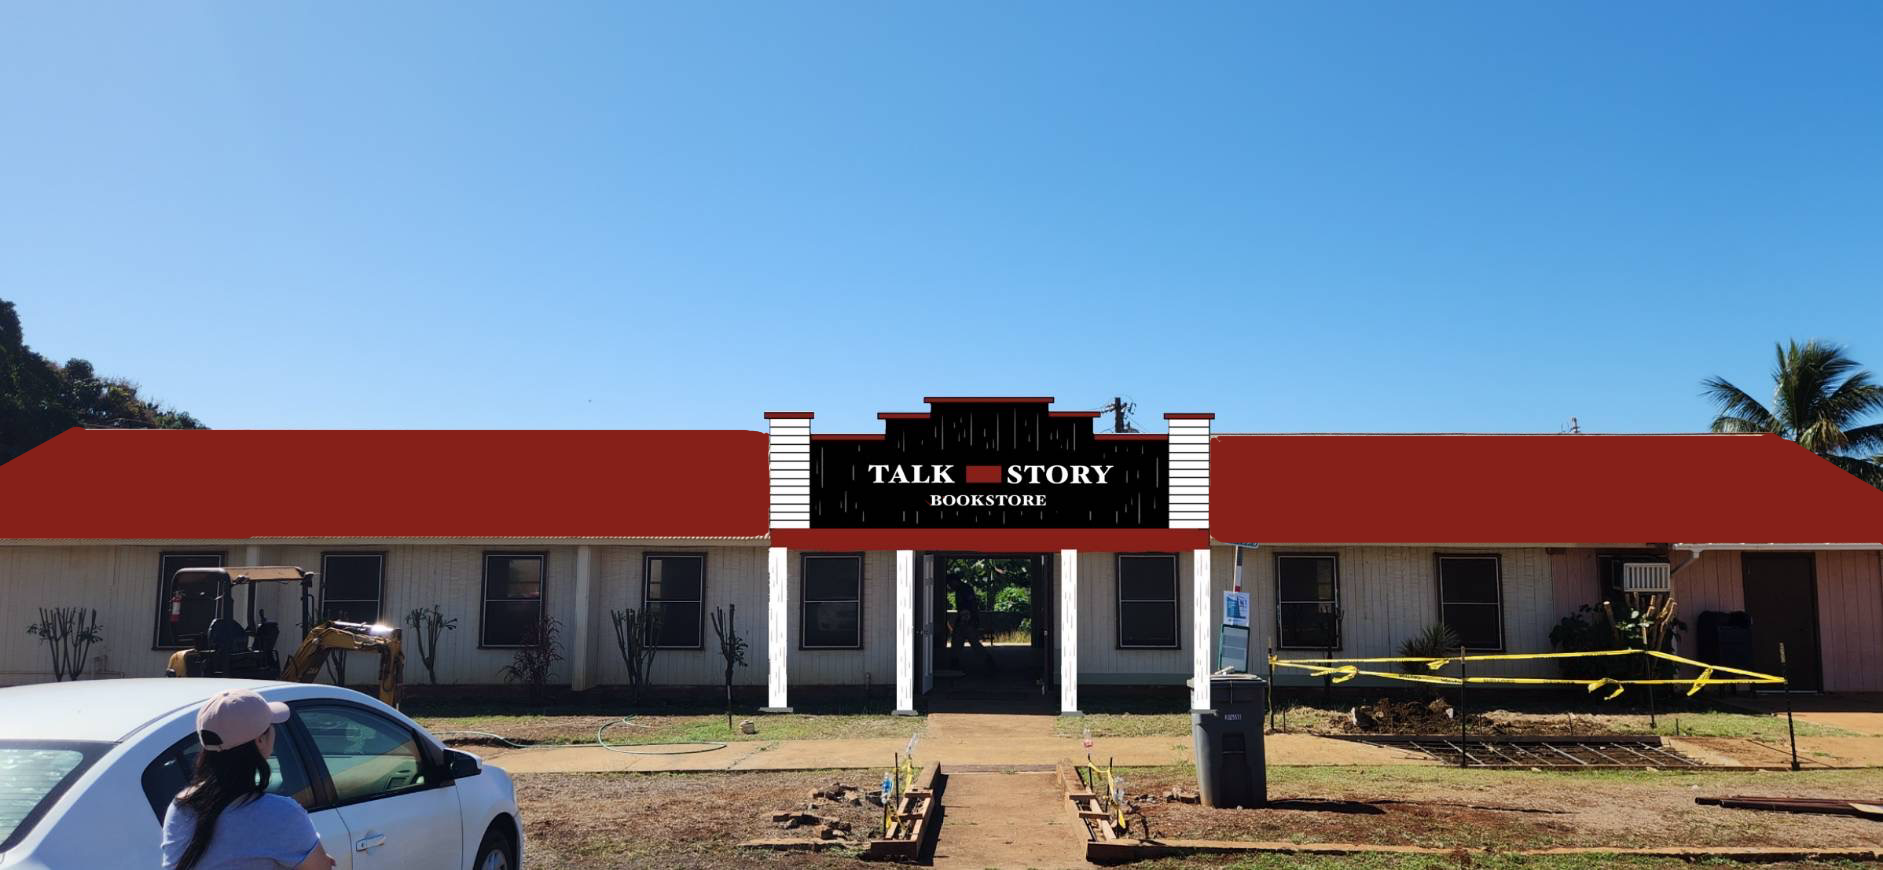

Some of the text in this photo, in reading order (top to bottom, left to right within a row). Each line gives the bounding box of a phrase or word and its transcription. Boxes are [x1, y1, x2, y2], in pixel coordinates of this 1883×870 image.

[868, 464, 1114, 484] TALK STORY
[930, 494, 1047, 506] BOOKSTORE
